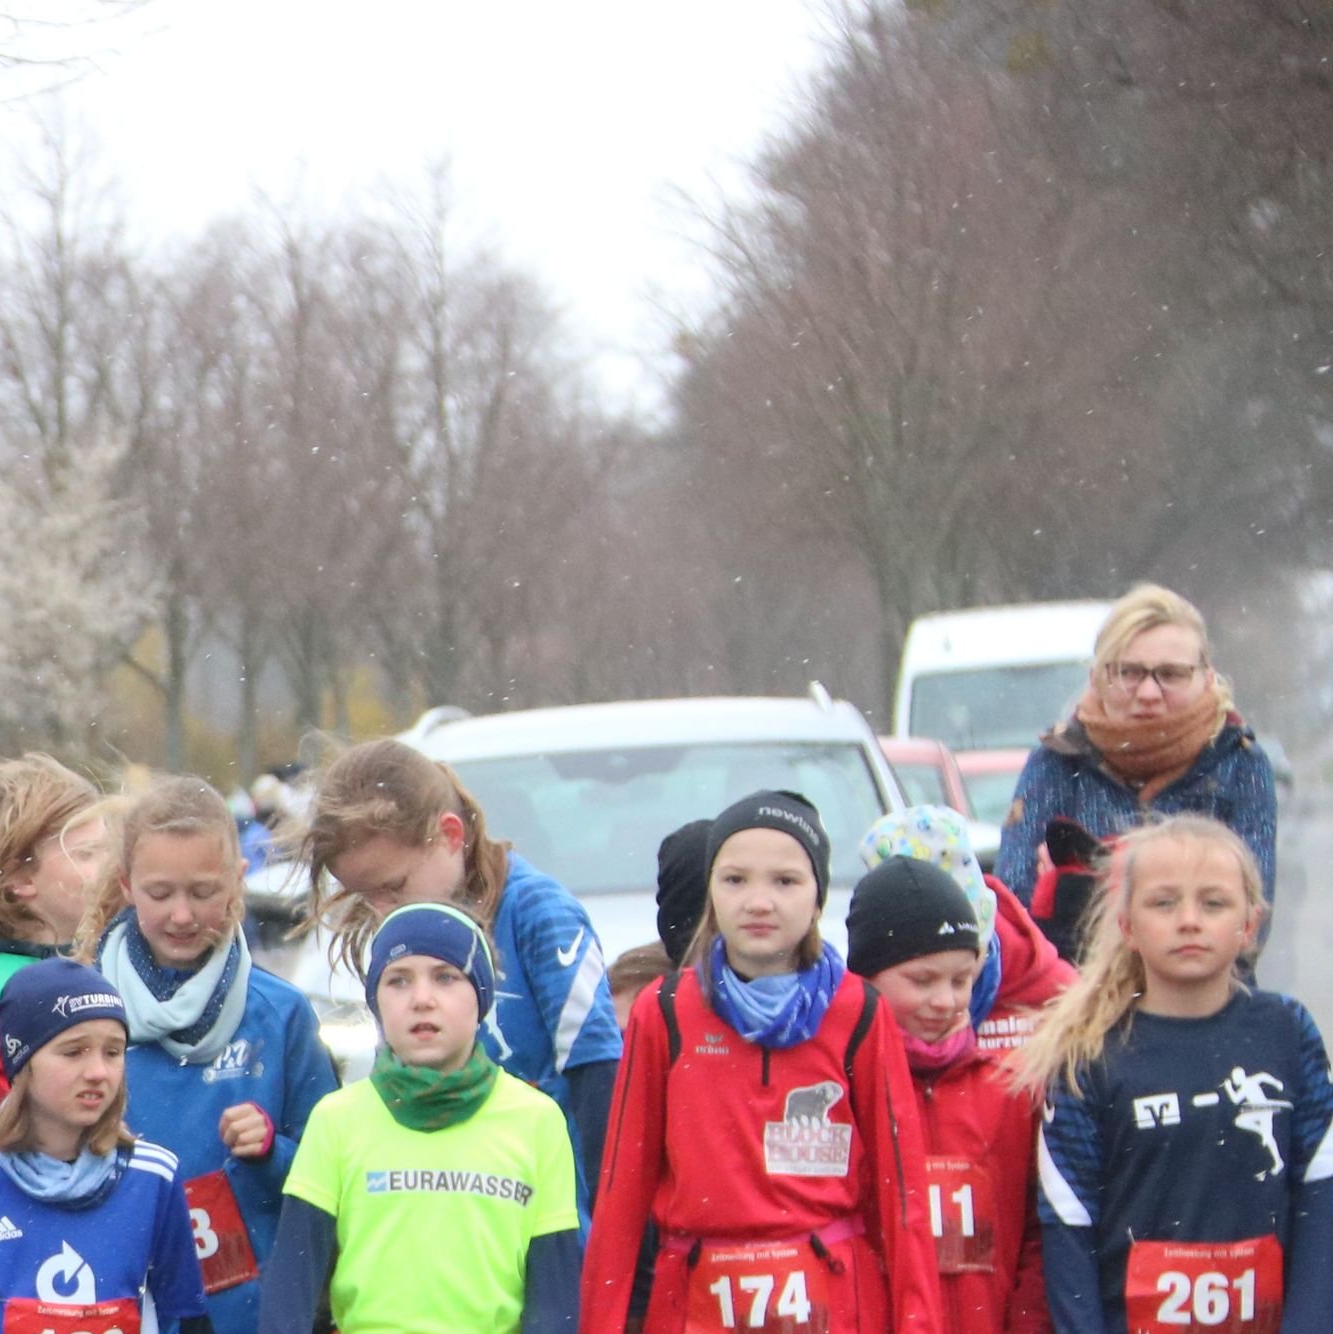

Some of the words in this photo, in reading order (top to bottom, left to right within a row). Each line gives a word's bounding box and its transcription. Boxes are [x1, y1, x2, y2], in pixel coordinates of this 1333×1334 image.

[37, 1305, 84, 1318] Zeitmessung
[710, 1270, 812, 1328] 174
[1157, 1268, 1255, 1326] 261
